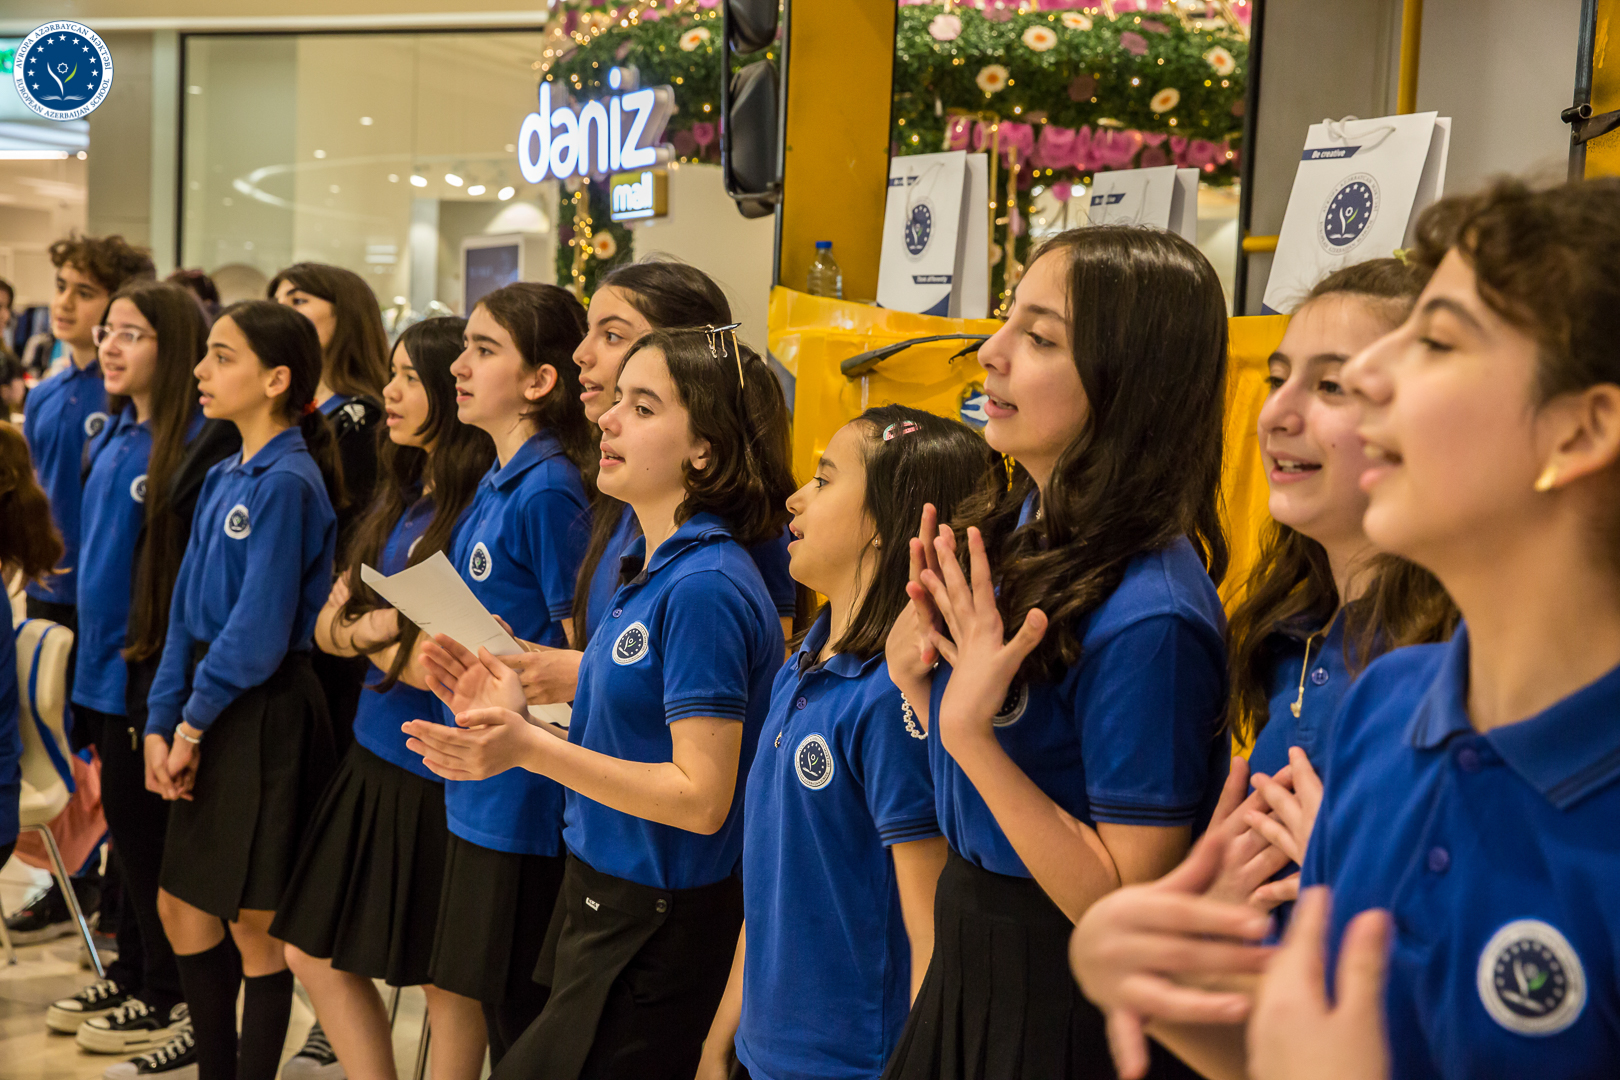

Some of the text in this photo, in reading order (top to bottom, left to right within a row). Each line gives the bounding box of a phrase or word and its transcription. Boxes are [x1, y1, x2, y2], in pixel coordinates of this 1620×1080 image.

[518, 66, 657, 184] daniz
[1321, 149, 1346, 158] creative
[613, 171, 653, 212] mall
